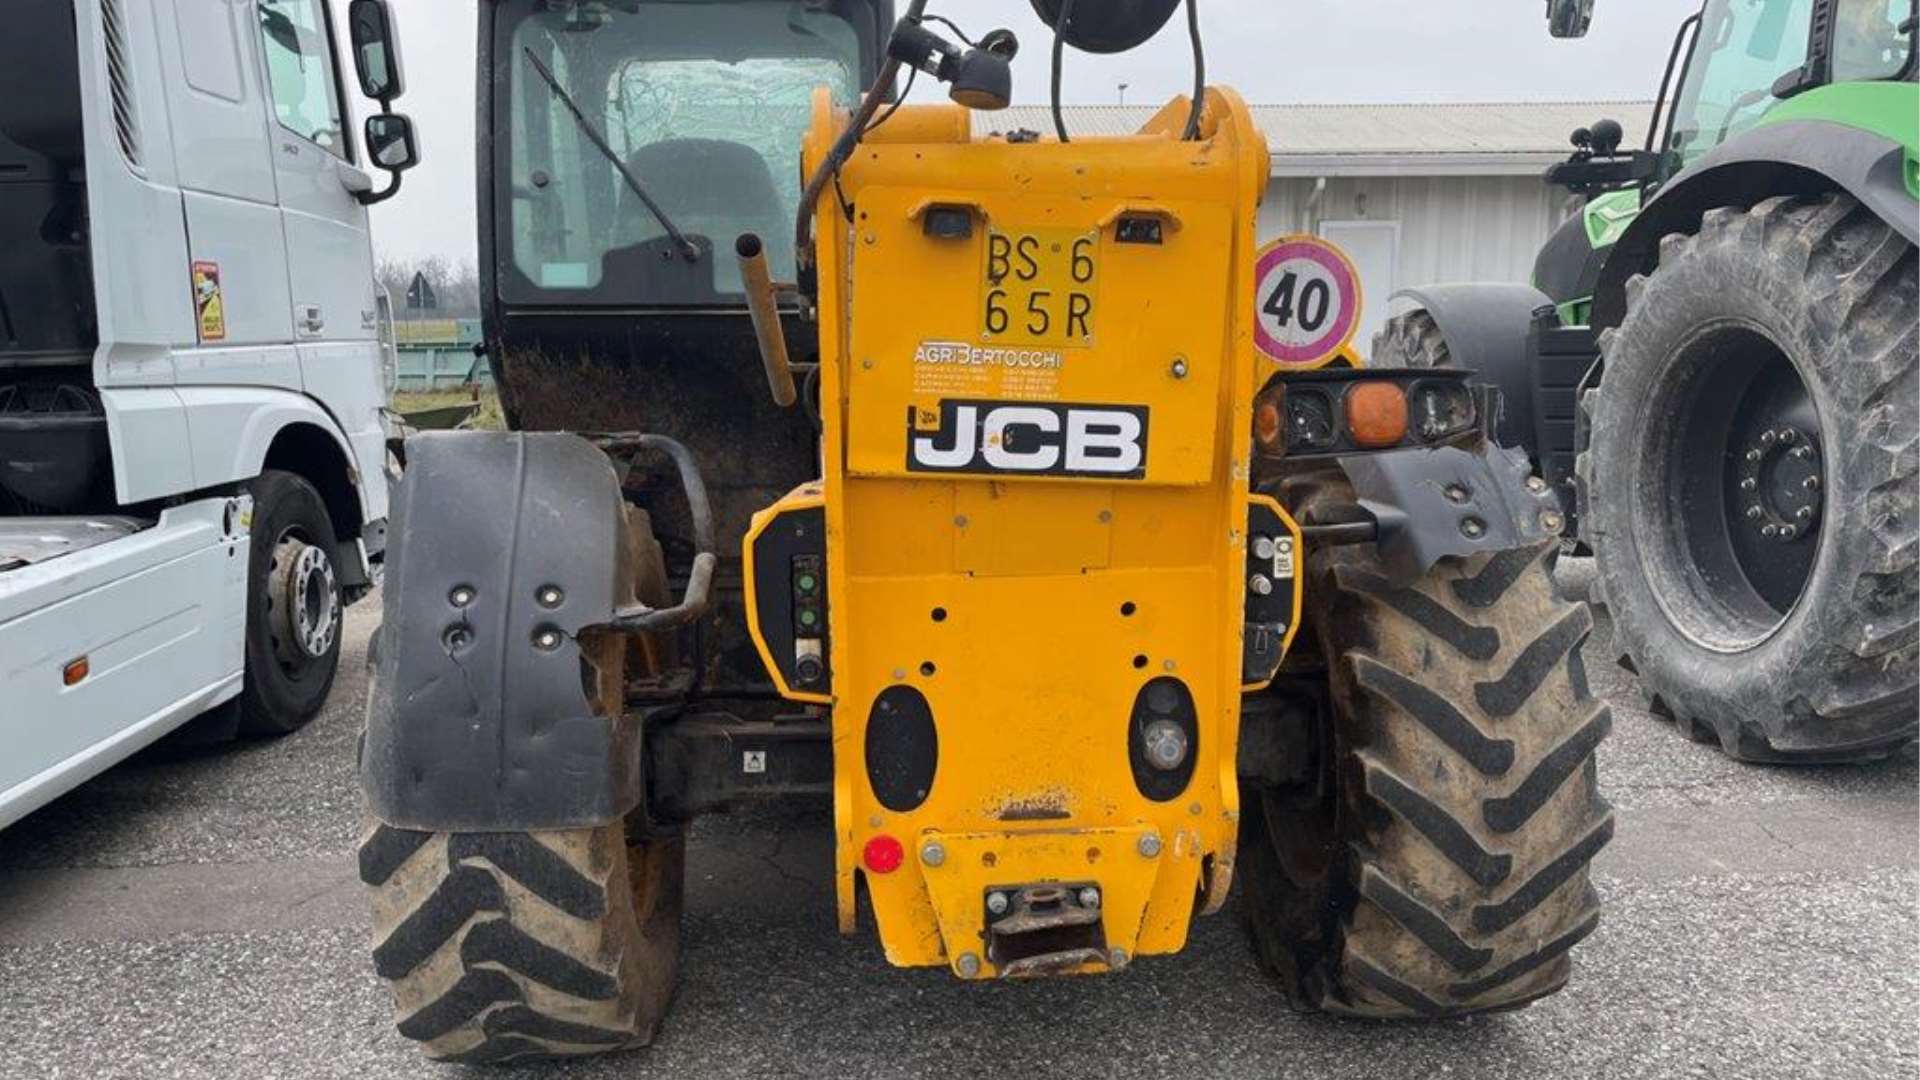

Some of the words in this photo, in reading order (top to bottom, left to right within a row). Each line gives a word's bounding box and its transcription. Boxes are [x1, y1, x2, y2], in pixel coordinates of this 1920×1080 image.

[987, 234, 1039, 281] BS
[1071, 237, 1093, 283] 6
[1263, 271, 1330, 332] 40
[914, 406, 1142, 472] JCB
